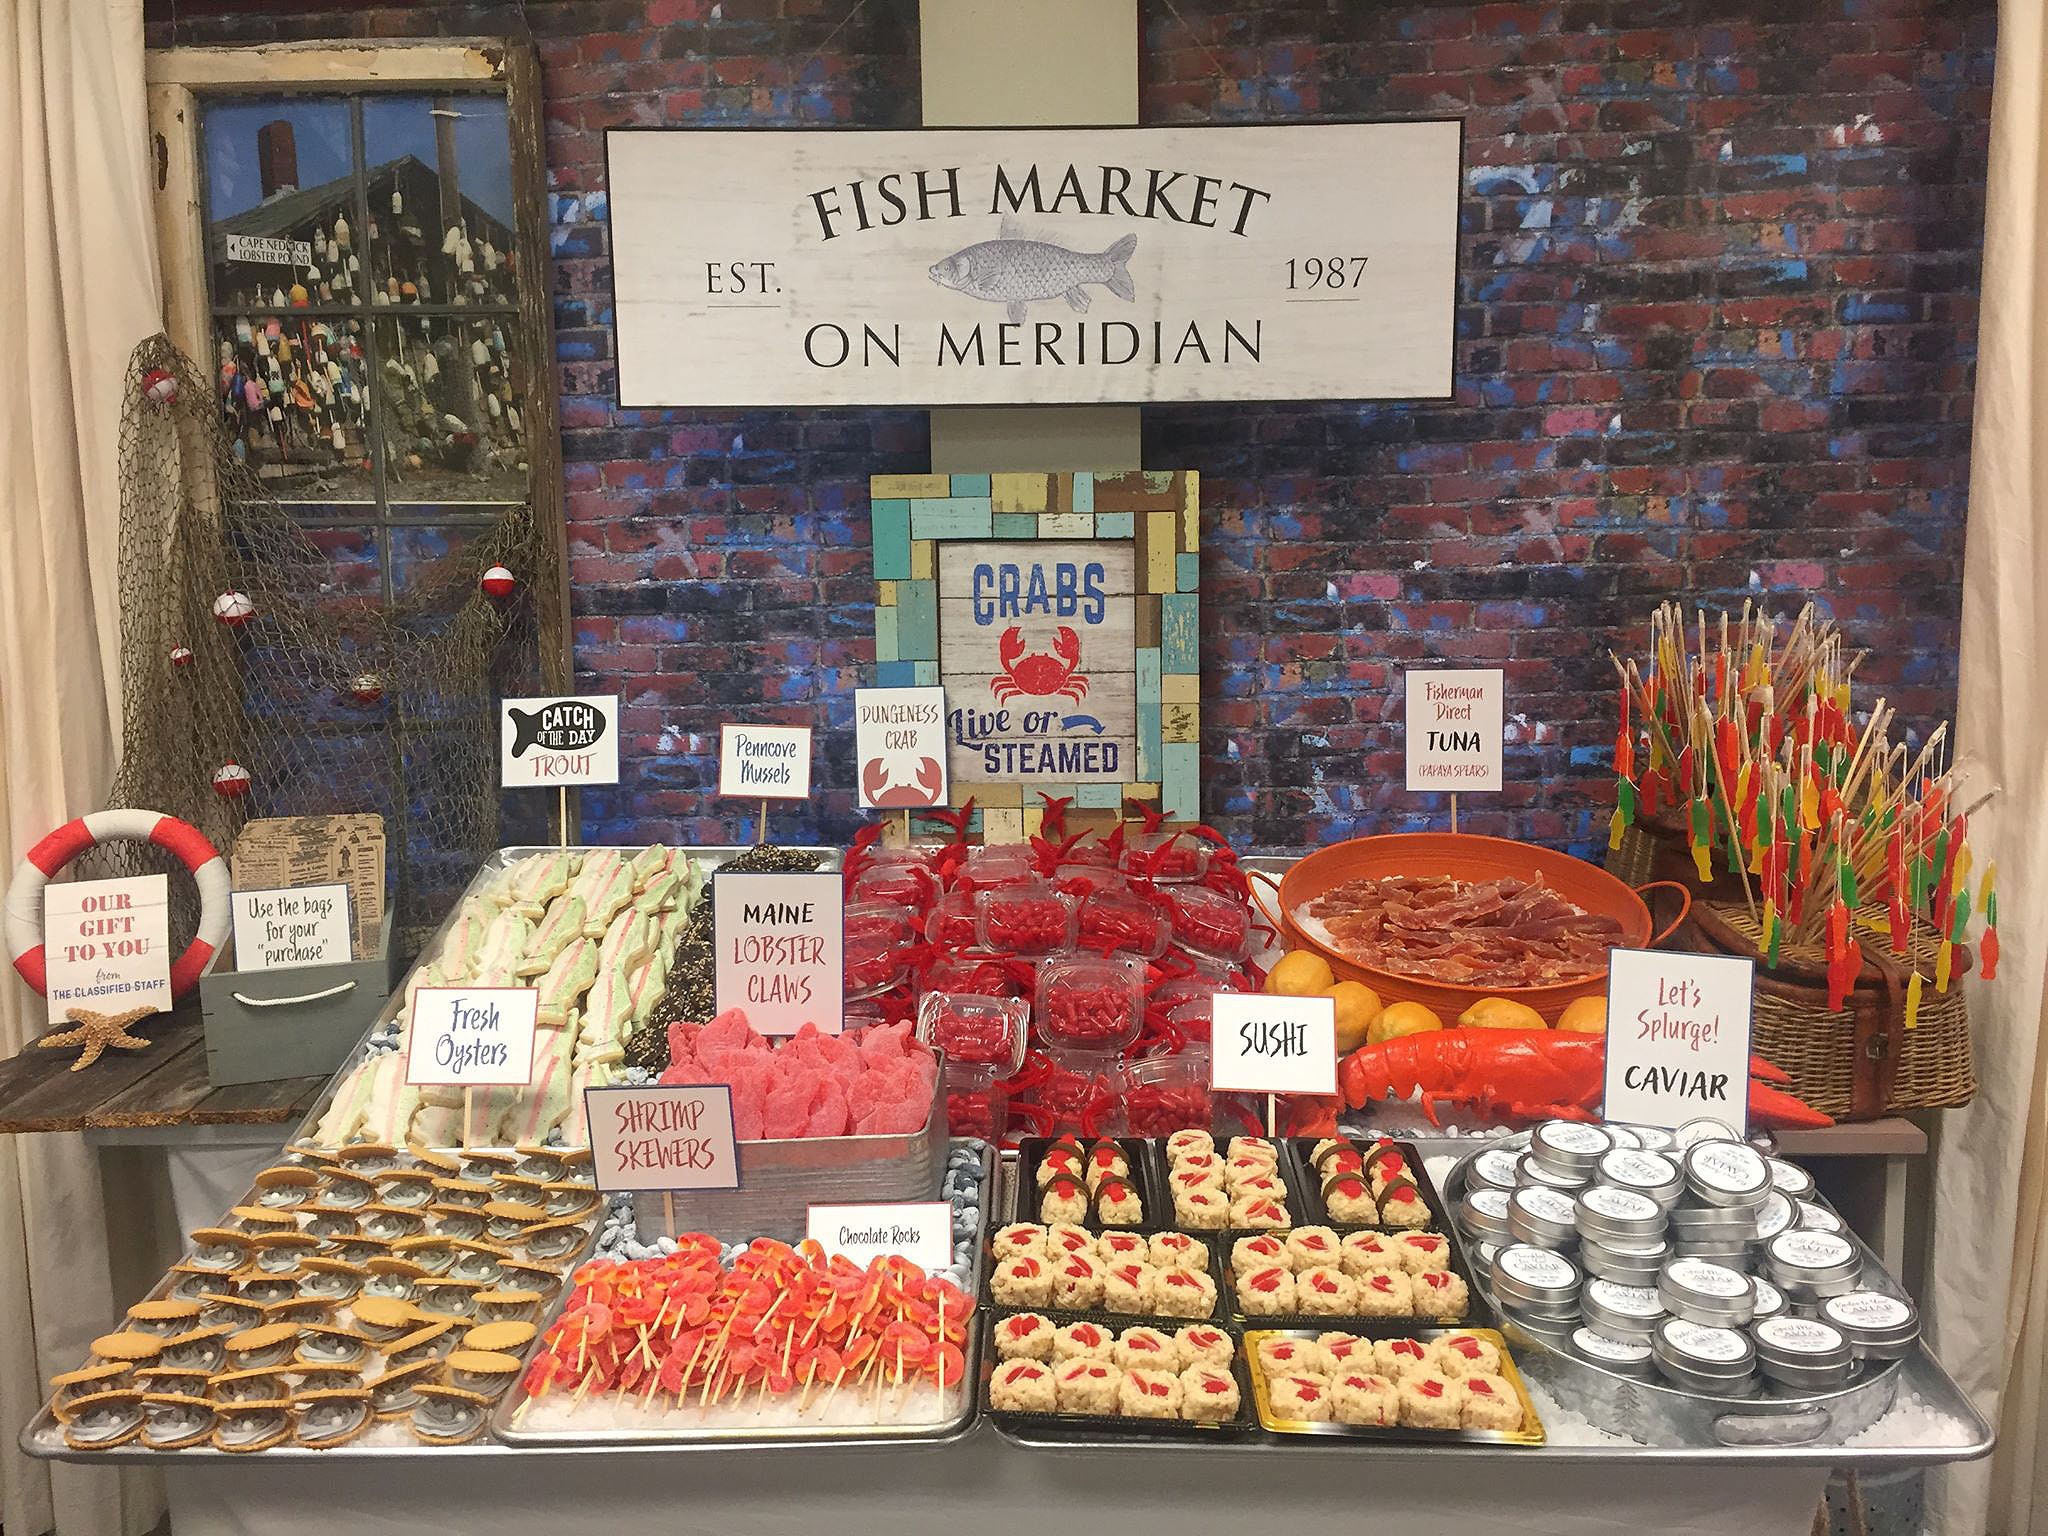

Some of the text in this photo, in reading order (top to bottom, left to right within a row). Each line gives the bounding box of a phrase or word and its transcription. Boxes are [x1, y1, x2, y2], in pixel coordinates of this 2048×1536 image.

[808, 163, 1271, 242] FISH MARKET
[240, 236, 264, 250] CAPE
[240, 249, 276, 262] LOBSTER
[705, 262, 782, 294] EST.
[1285, 256, 1369, 291] 1987
[803, 318, 1263, 369] ON MERIDIAN
[972, 562, 1105, 627] CRABS
[1425, 680, 1484, 701] Fisherman
[542, 705, 594, 731] CATCH
[861, 704, 939, 726] DUNGENESS
[1433, 701, 1472, 721] Direct
[536, 729, 596, 746] OF THE DAY
[884, 729, 918, 751] CRAB
[946, 708, 1059, 751] Live or
[1426, 731, 1481, 753] TUNA
[734, 733, 797, 758] Penncove
[984, 742, 1119, 774] STEAMED
[529, 752, 598, 777] TROUT
[740, 759, 791, 785] Mussels
[1418, 764, 1490, 778] (PAPAYA SPEARS)
[81, 893, 133, 913] OUR
[248, 897, 274, 919] Use
[277, 896, 300, 918] the
[303, 896, 334, 920] bags
[743, 902, 816, 926] MAINE
[79, 916, 135, 937] GIFT
[265, 921, 320, 945] for your
[63, 938, 150, 963] TO YOU
[733, 934, 827, 966] LOBSTER
[95, 967, 121, 984] from
[53, 979, 166, 1000] THE CLASSIFIED STAFF
[747, 974, 813, 1005] CLAWS
[1657, 977, 1702, 1008] Let's
[450, 998, 501, 1032] Fresh
[1239, 1020, 1308, 1057] SUSHI
[1636, 1008, 1720, 1052] Splurge!
[435, 1033, 508, 1075] Oysters
[1624, 1065, 1729, 1101] CAVIAR
[614, 1099, 706, 1135] SHRIMP
[614, 1137, 715, 1172] SKEWERS
[839, 1225, 921, 1246] Chocolate Rocks
